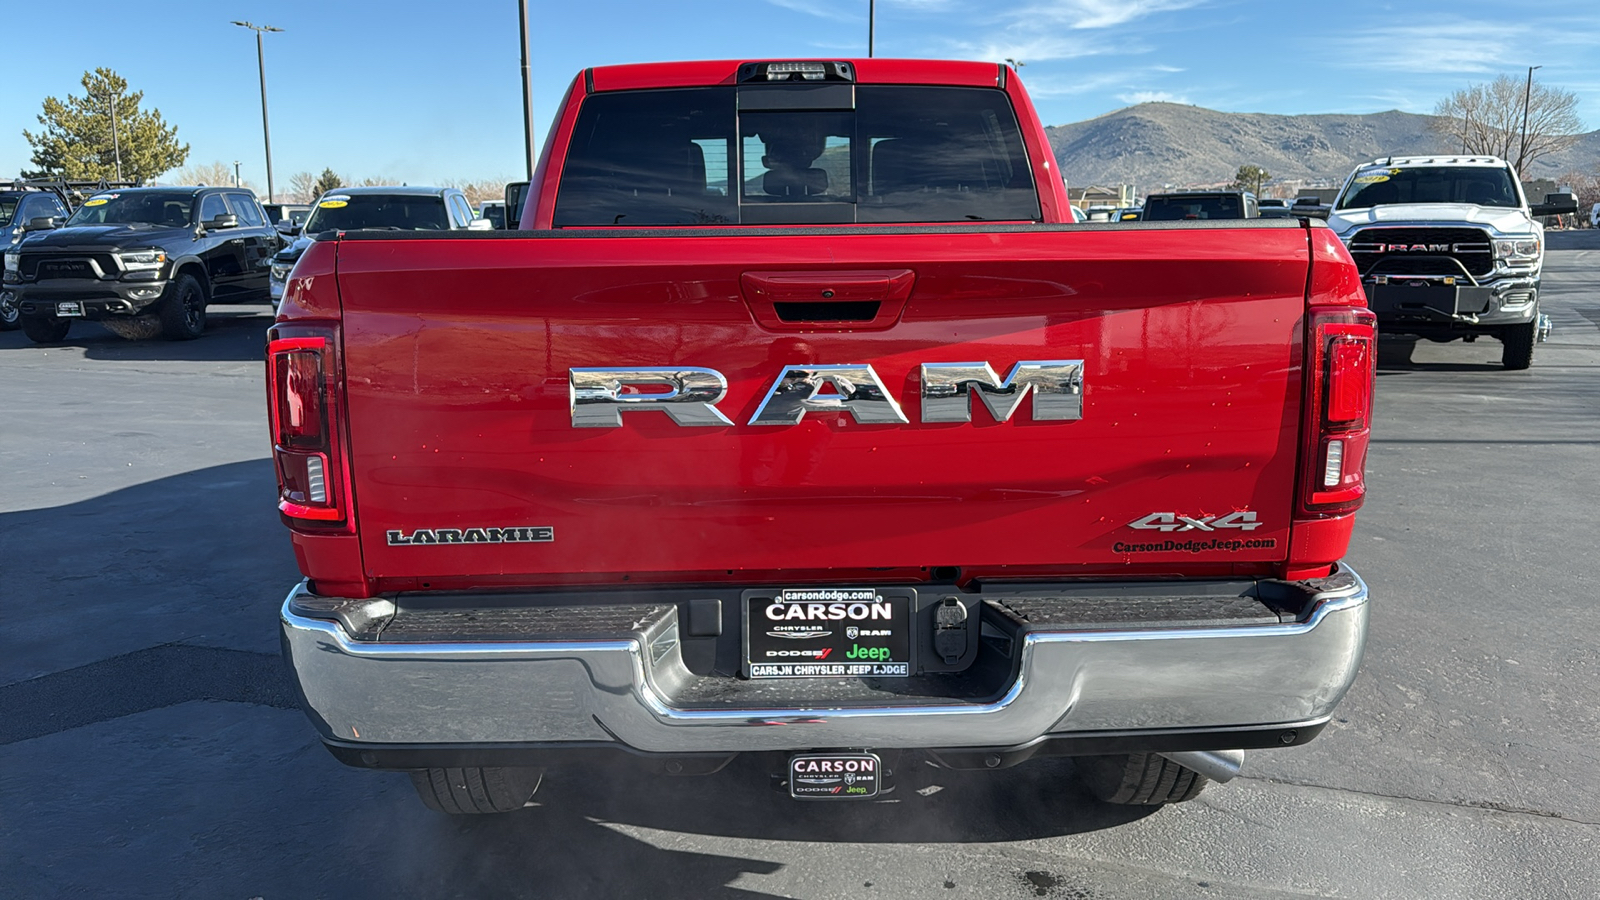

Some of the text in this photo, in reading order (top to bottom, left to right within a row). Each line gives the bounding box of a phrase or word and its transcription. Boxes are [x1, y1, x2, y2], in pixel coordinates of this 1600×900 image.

[1388, 244, 1449, 252] RAM
[569, 359, 1085, 428] RAM
[1127, 511, 1263, 532] 4x4
[386, 526, 555, 546] LARAMIE
[1113, 539, 1276, 553] CarsonDodgeJeep.com
[785, 591, 873, 601] carsondodge.com
[765, 603, 892, 620] CARSON
[846, 643, 890, 661] Jeep
[794, 665, 845, 675] CHRYSLER
[847, 665, 871, 674] JEEP
[794, 760, 874, 772] CARSON
[846, 786, 866, 794] Jeep
